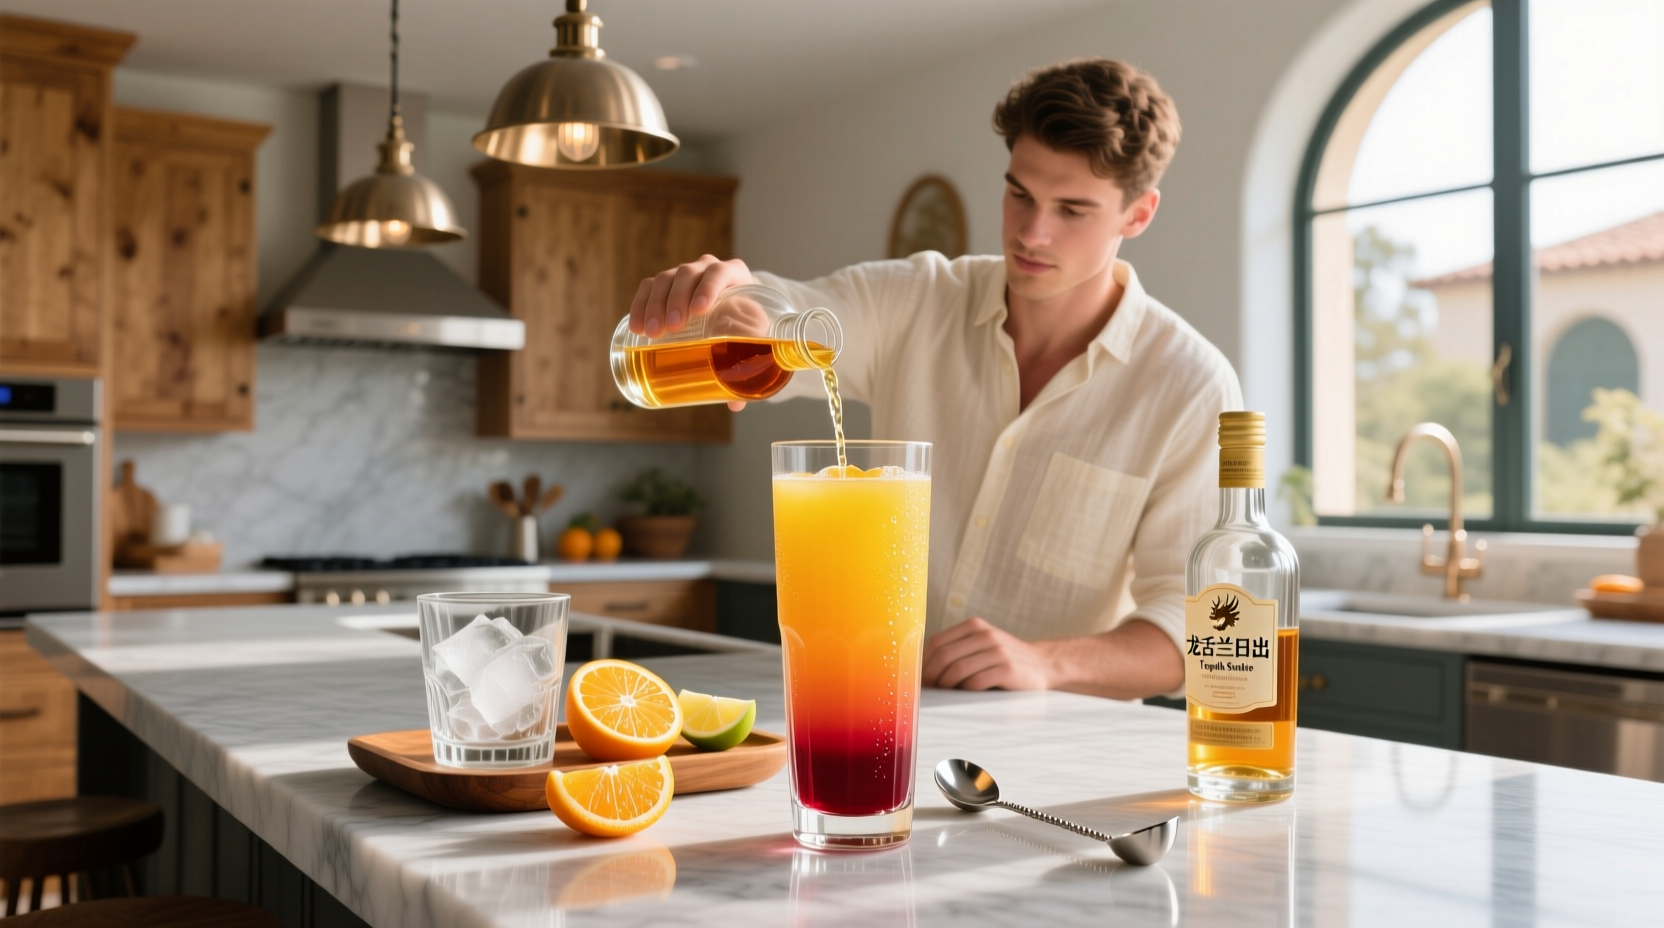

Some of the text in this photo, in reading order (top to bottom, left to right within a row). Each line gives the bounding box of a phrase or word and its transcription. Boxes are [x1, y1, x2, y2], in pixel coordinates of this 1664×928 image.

[1186, 634, 1269, 658] 龙舌兰日出
